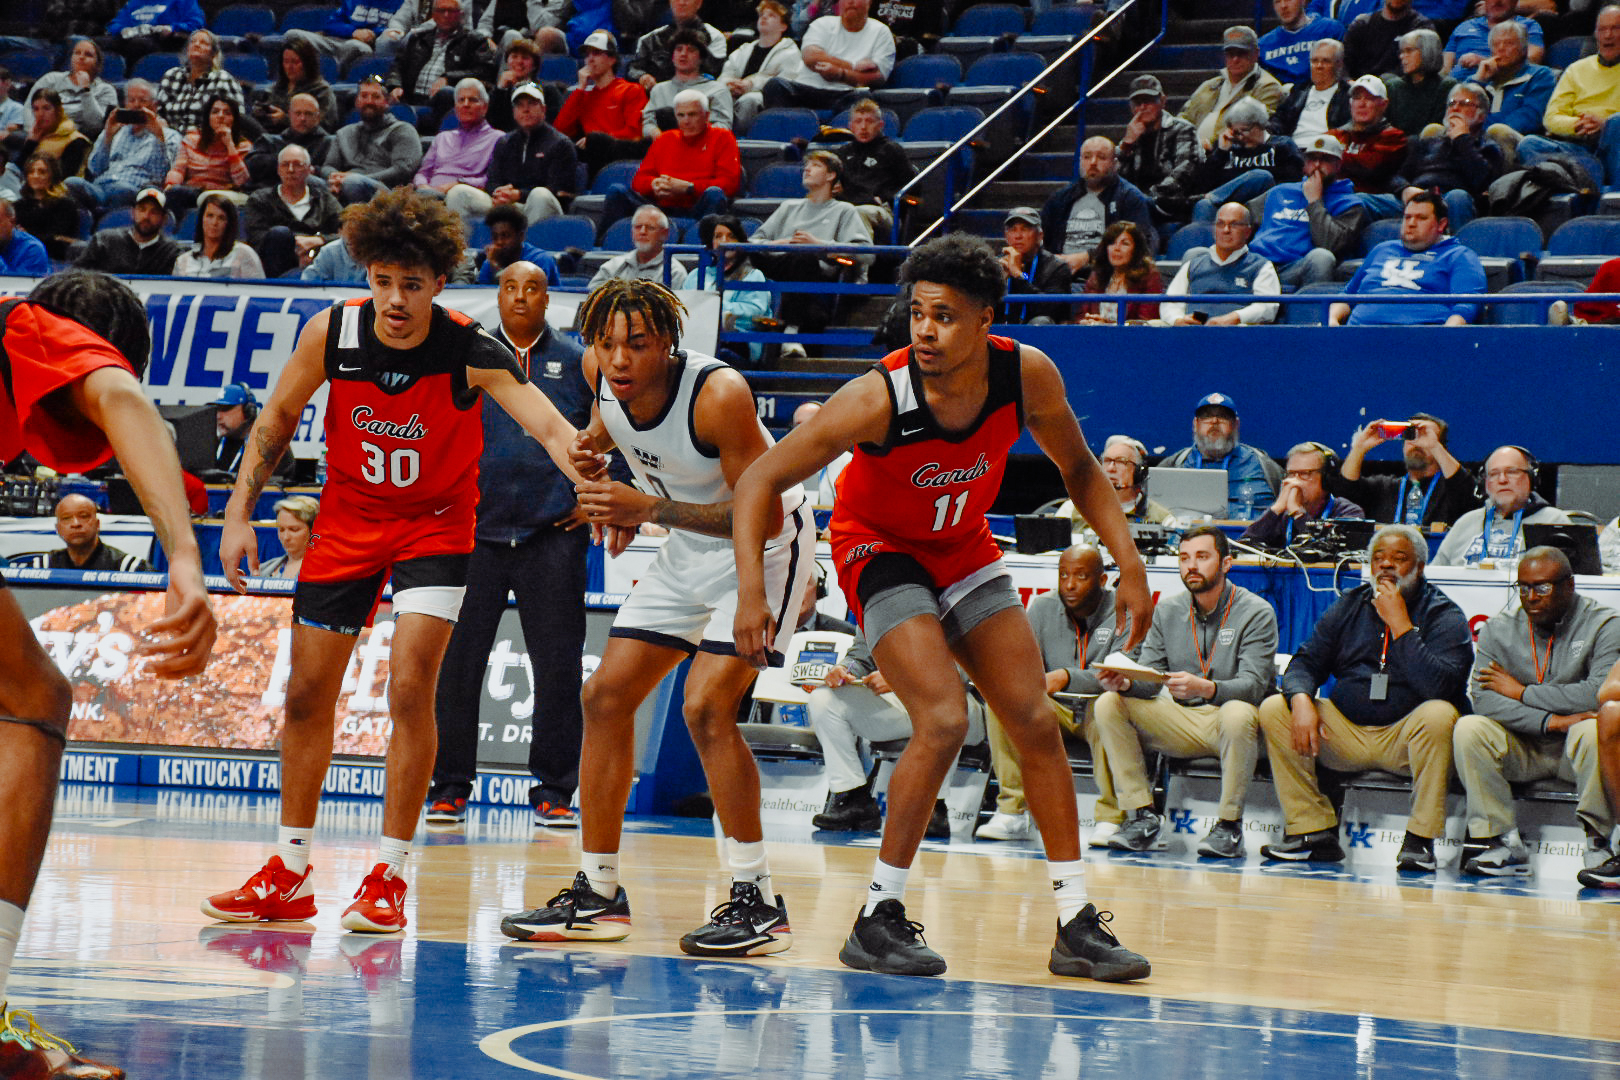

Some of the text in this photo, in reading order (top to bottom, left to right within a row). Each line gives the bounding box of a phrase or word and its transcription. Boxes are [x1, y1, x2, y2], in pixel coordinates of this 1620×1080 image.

[1265, 41, 1313, 60] KENTUCK
[147, 294, 335, 389] WEET
[351, 405, 428, 440] Cards
[361, 440, 420, 488] 30
[910, 452, 992, 489] Cards
[932, 490, 969, 532] 11
[19, 569, 52, 579] BUREAU
[82, 571, 164, 585] BIG ON COMMITMENT
[263, 580, 296, 590] BUREAU
[589, 594, 601, 605] ON
[793, 664, 827, 678] SWEET
[70, 702, 105, 721] NK.
[342, 715, 391, 735] GAT
[502, 724, 532, 743] DR
[60, 755, 119, 783] TMENT
[158, 758, 385, 795] KENTUCKY FA UREAU
[1169, 808, 1198, 834] UK
[1345, 821, 1375, 848] UK
[1536, 840, 1584, 856] Health
